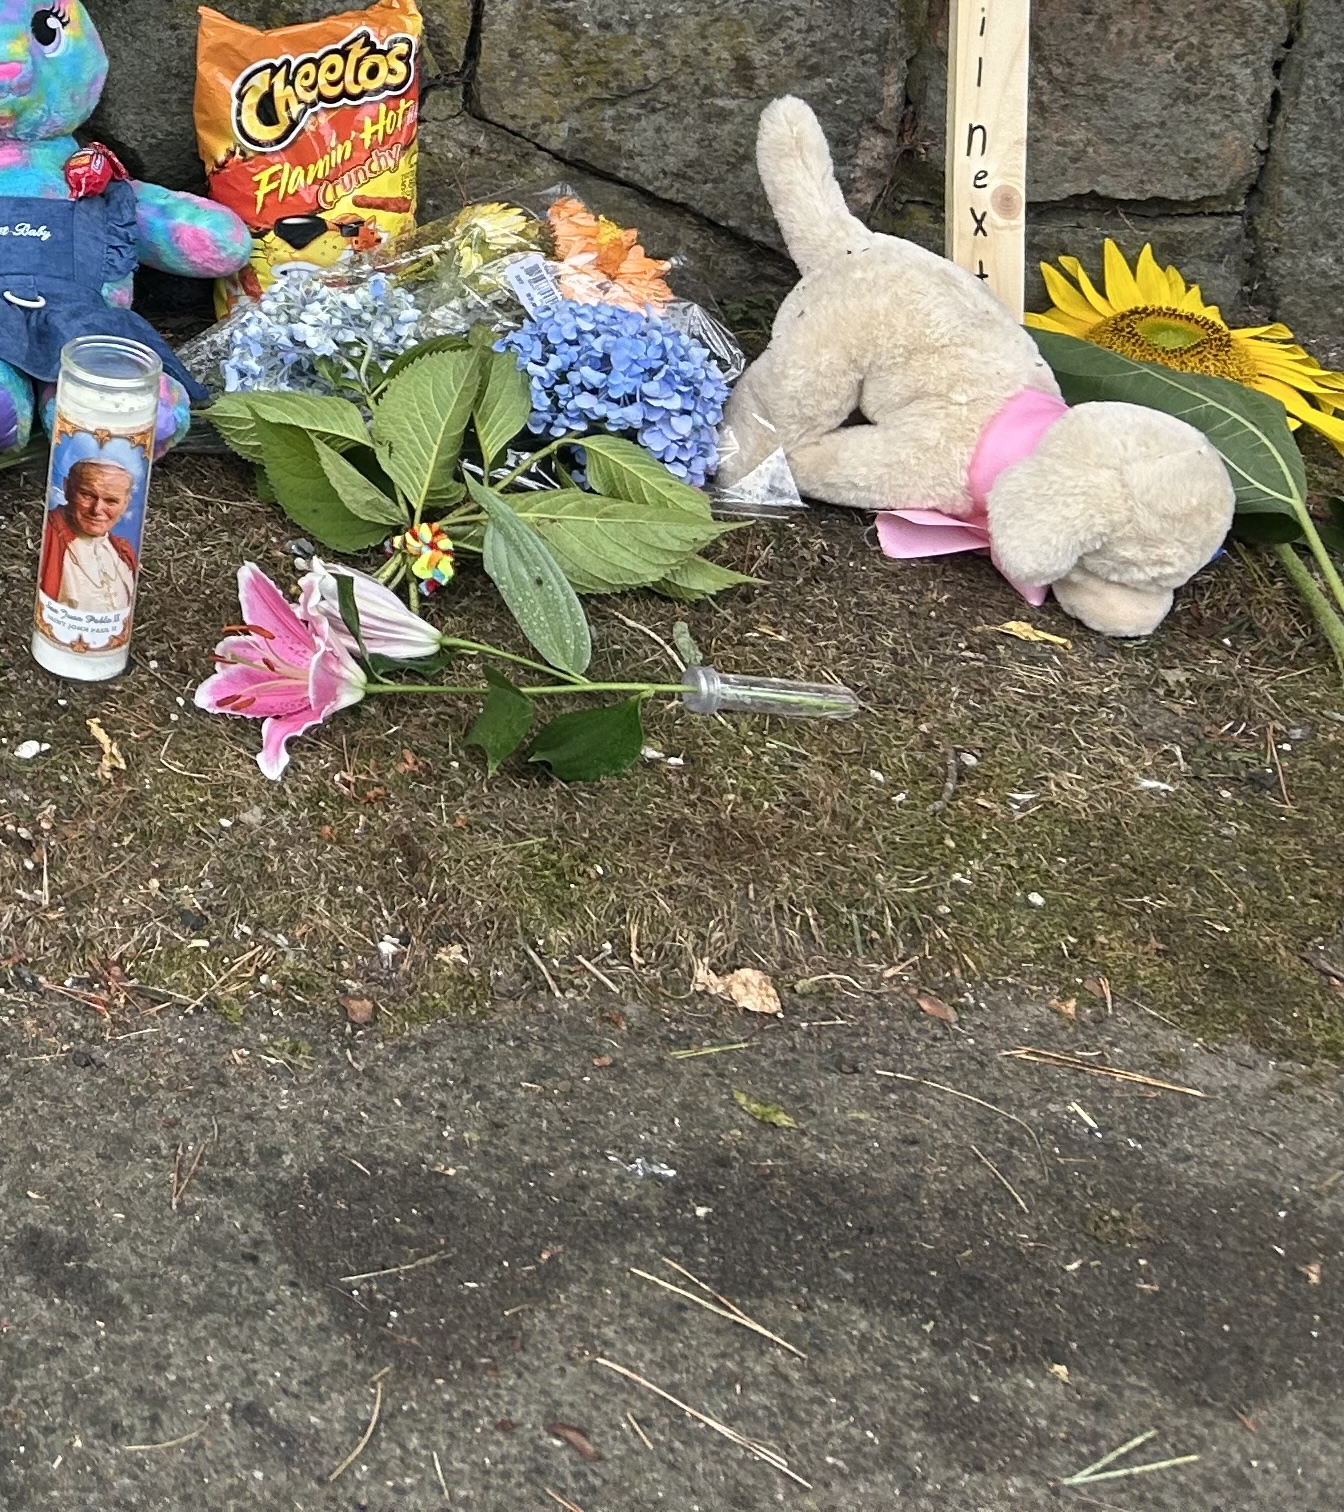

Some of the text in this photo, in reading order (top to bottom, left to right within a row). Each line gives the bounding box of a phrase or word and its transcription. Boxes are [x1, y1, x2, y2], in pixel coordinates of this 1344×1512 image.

[236, 29, 413, 146] Cheetos
[360, 97, 414, 149] Hot
[316, 142, 402, 211] Crunchy
